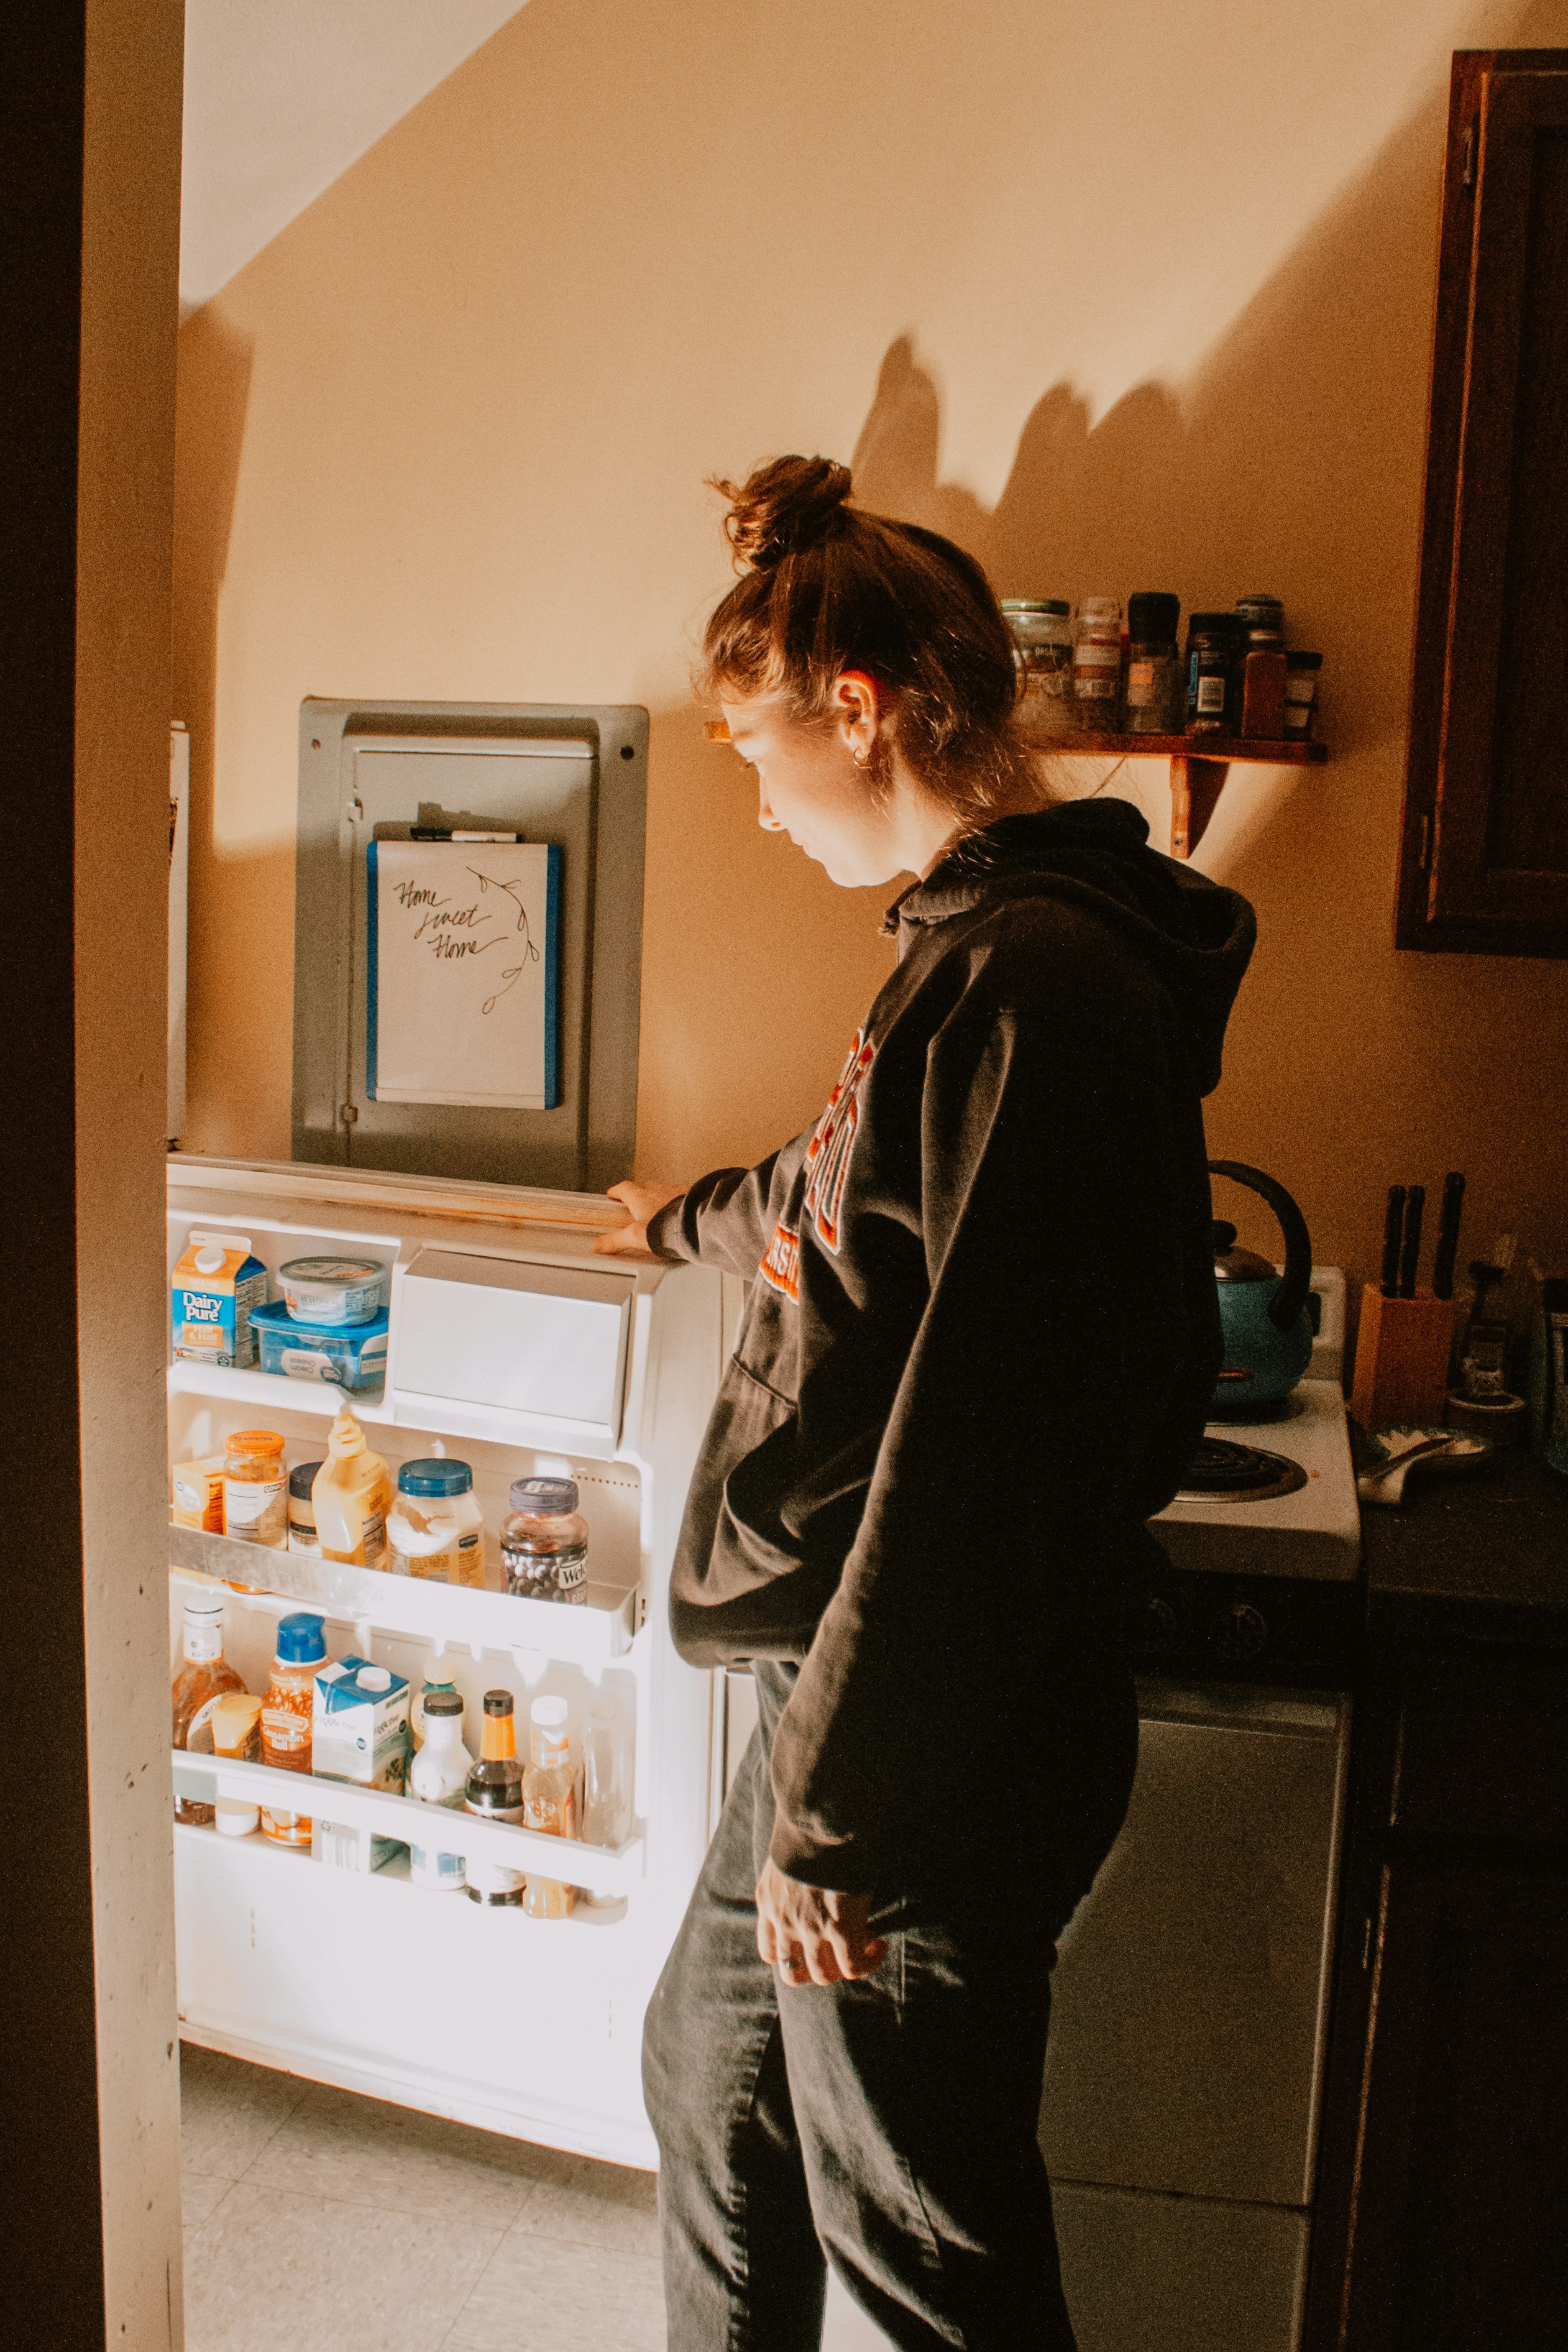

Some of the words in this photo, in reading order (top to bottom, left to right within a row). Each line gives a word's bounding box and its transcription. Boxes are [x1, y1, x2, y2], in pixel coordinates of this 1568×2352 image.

[393, 880, 452, 909] Home
[427, 934, 508, 958] Home
[183, 1292, 223, 1312] Dairy
[186, 1305, 219, 1322] Pure
[188, 1332, 196, 1340] &
[198, 1333, 218, 1341] Half
